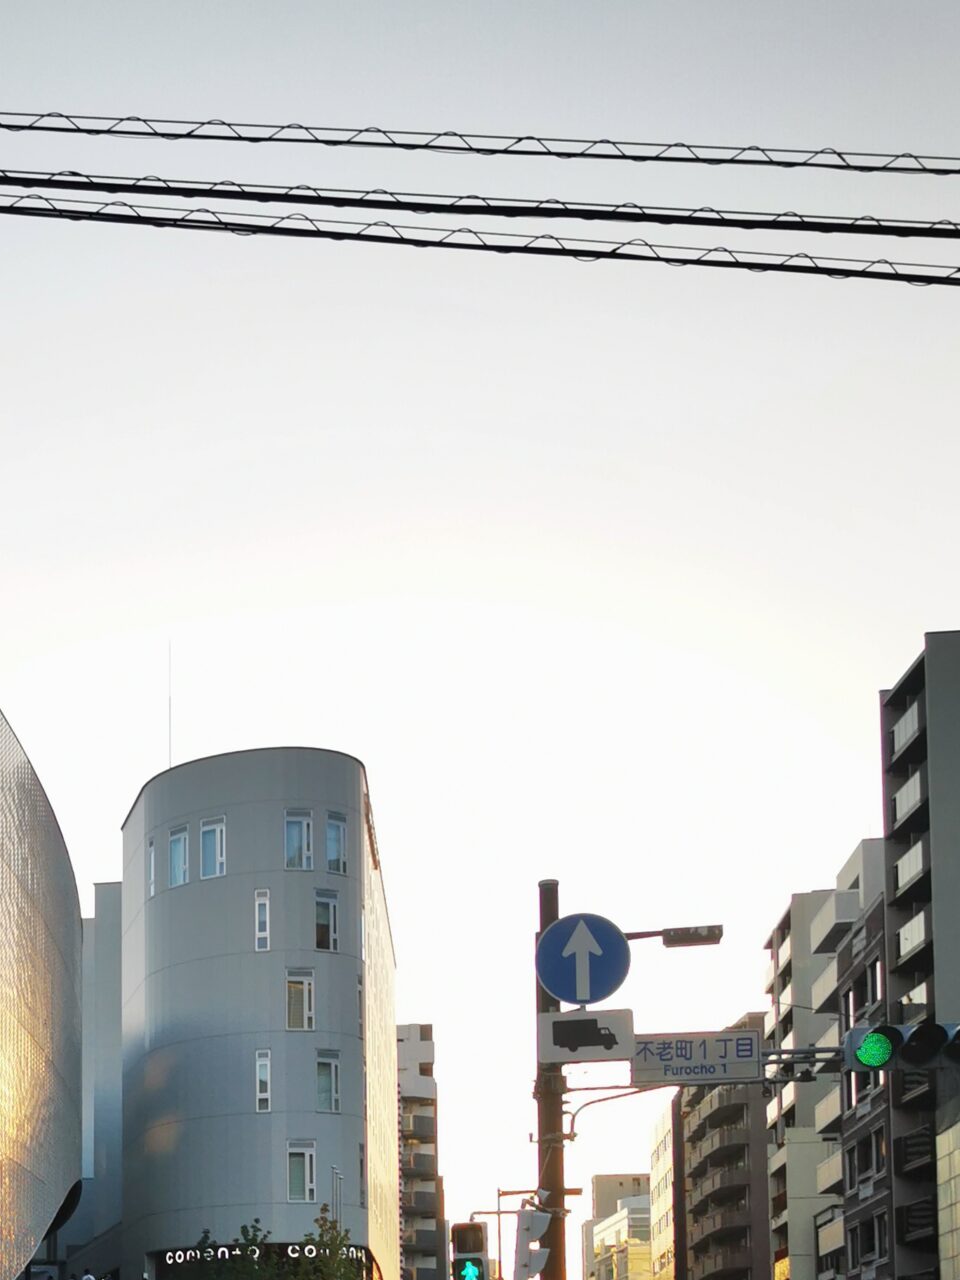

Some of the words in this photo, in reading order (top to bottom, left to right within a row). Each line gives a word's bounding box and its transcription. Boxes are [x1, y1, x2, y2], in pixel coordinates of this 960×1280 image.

[635, 1037, 753, 1062] 不老町1丁目
[663, 1063, 715, 1077] Furocho
[721, 1063, 727, 1074] 1
